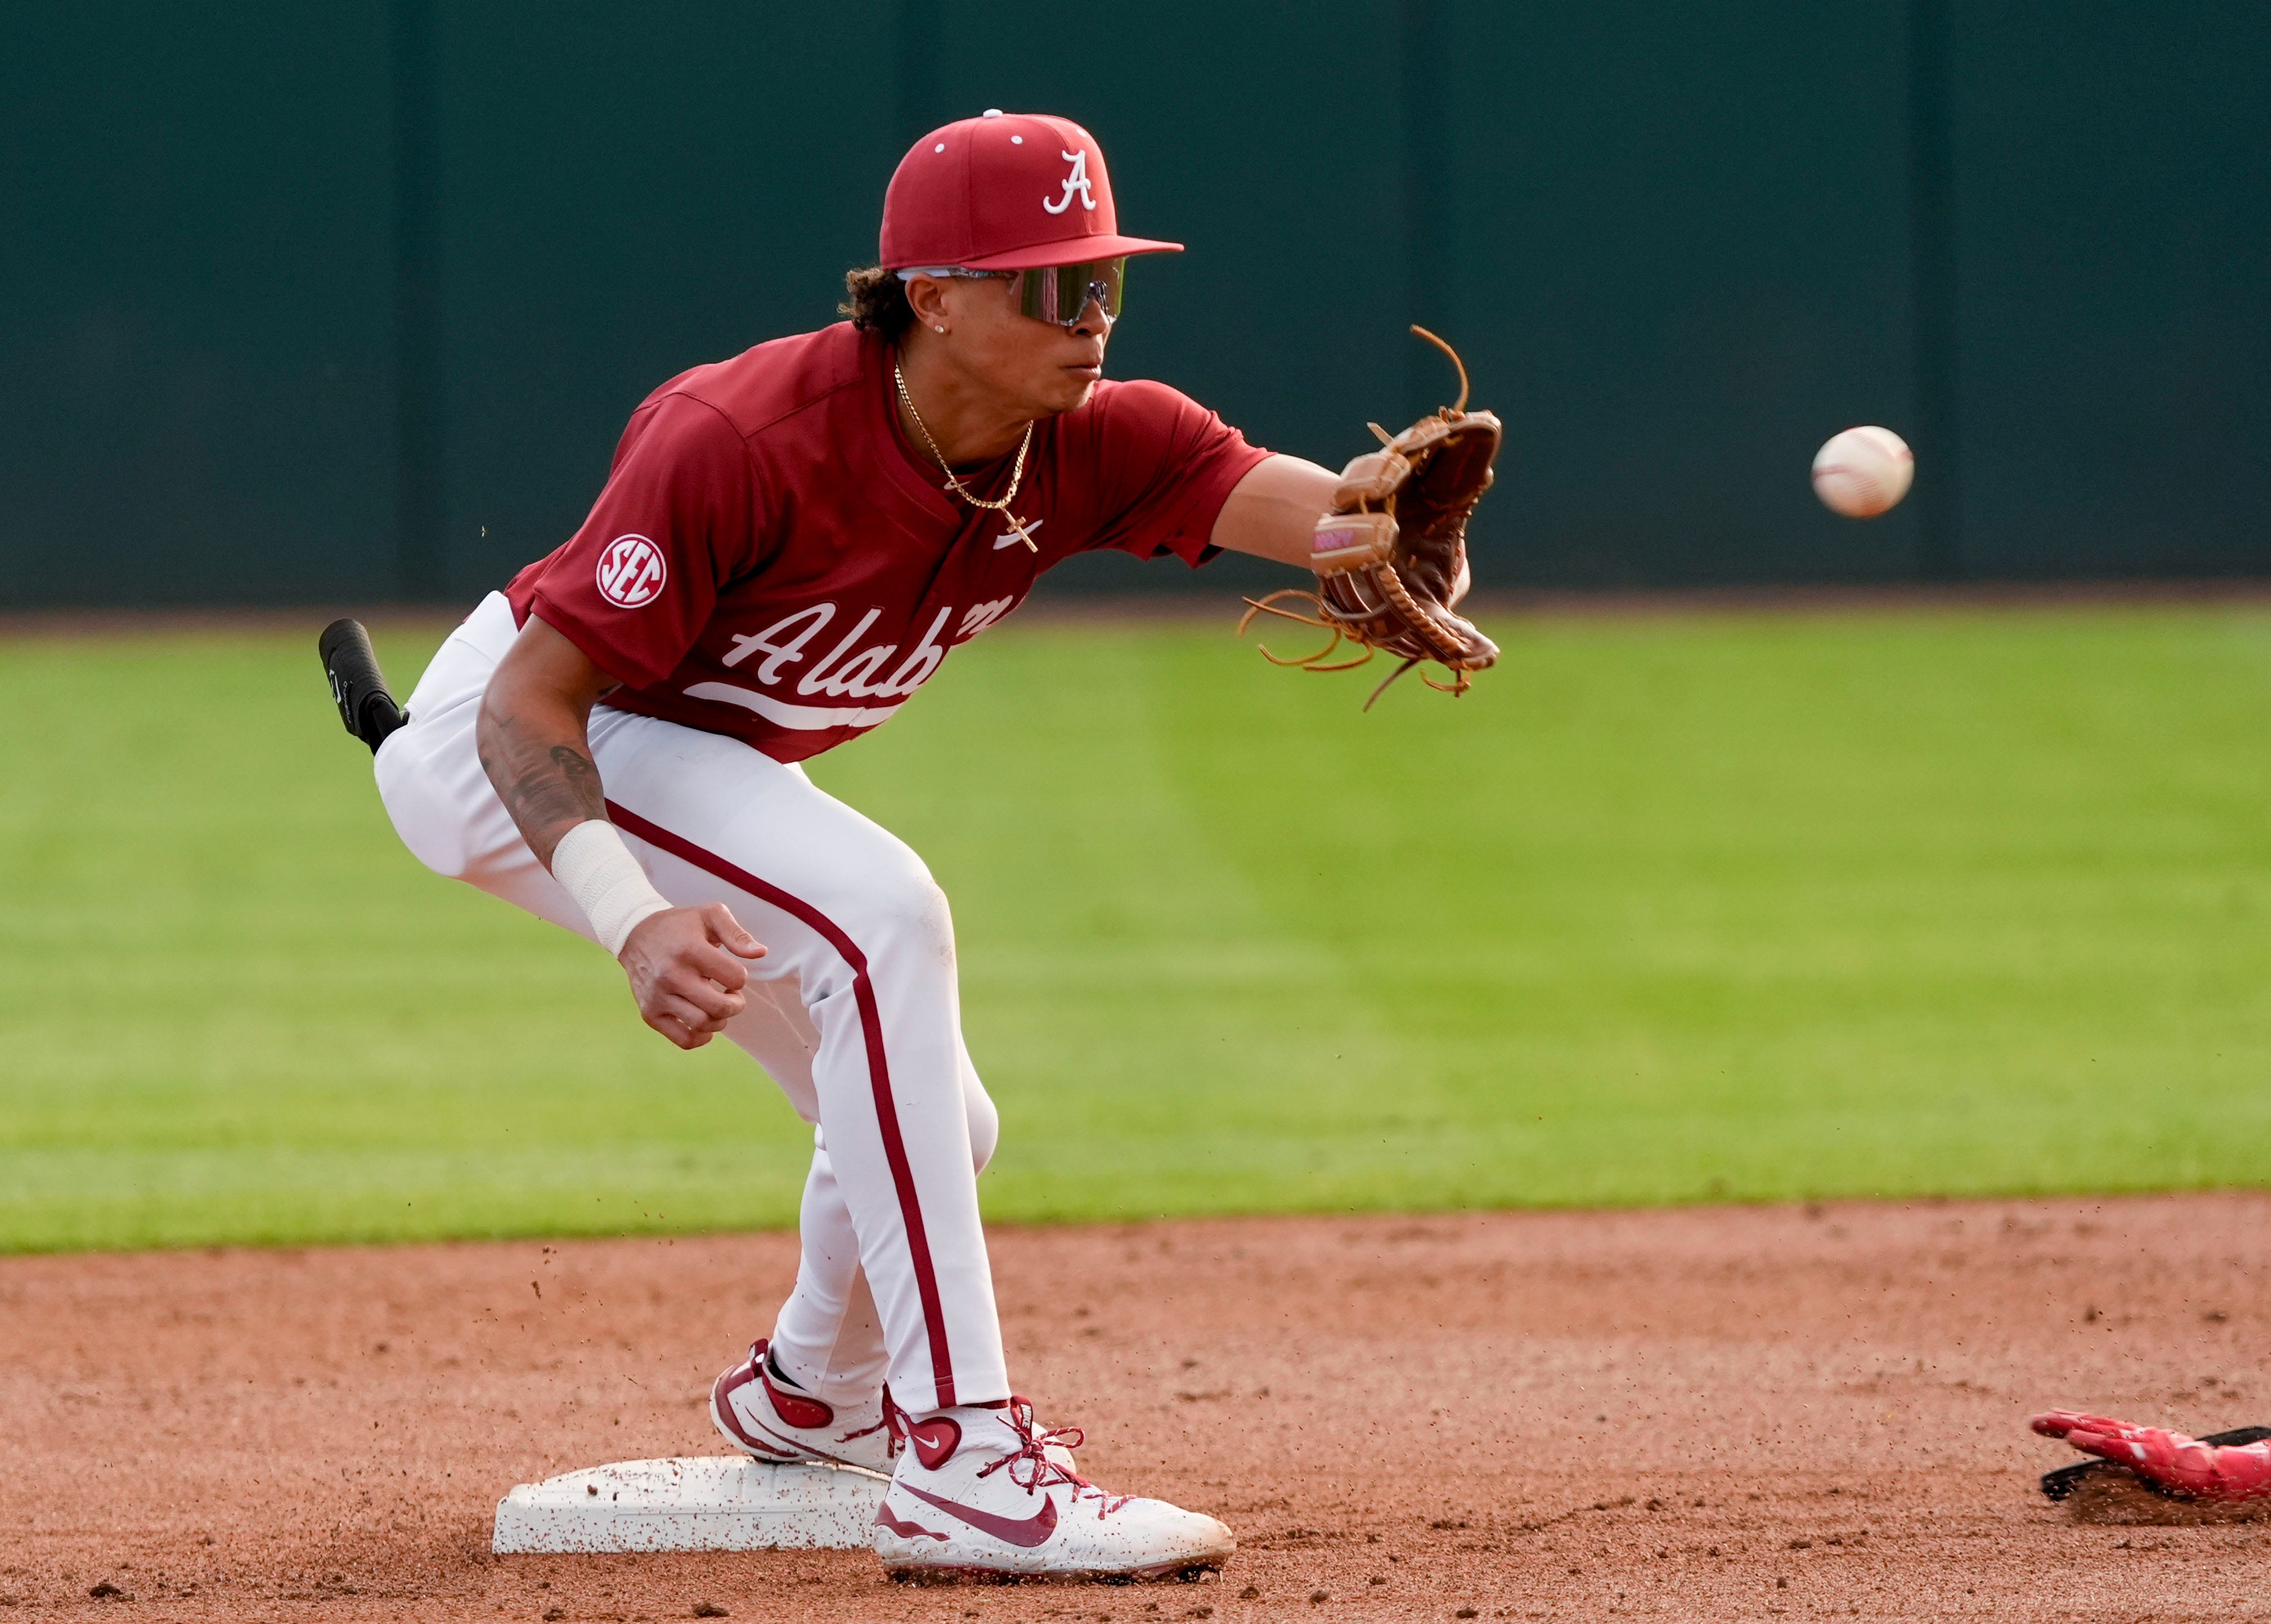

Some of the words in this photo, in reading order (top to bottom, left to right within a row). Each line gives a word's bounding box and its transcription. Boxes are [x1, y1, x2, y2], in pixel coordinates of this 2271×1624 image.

[1043, 149, 1096, 214] A
[602, 540, 661, 602] SEC
[1020, 1404, 1032, 1429] NIKE
